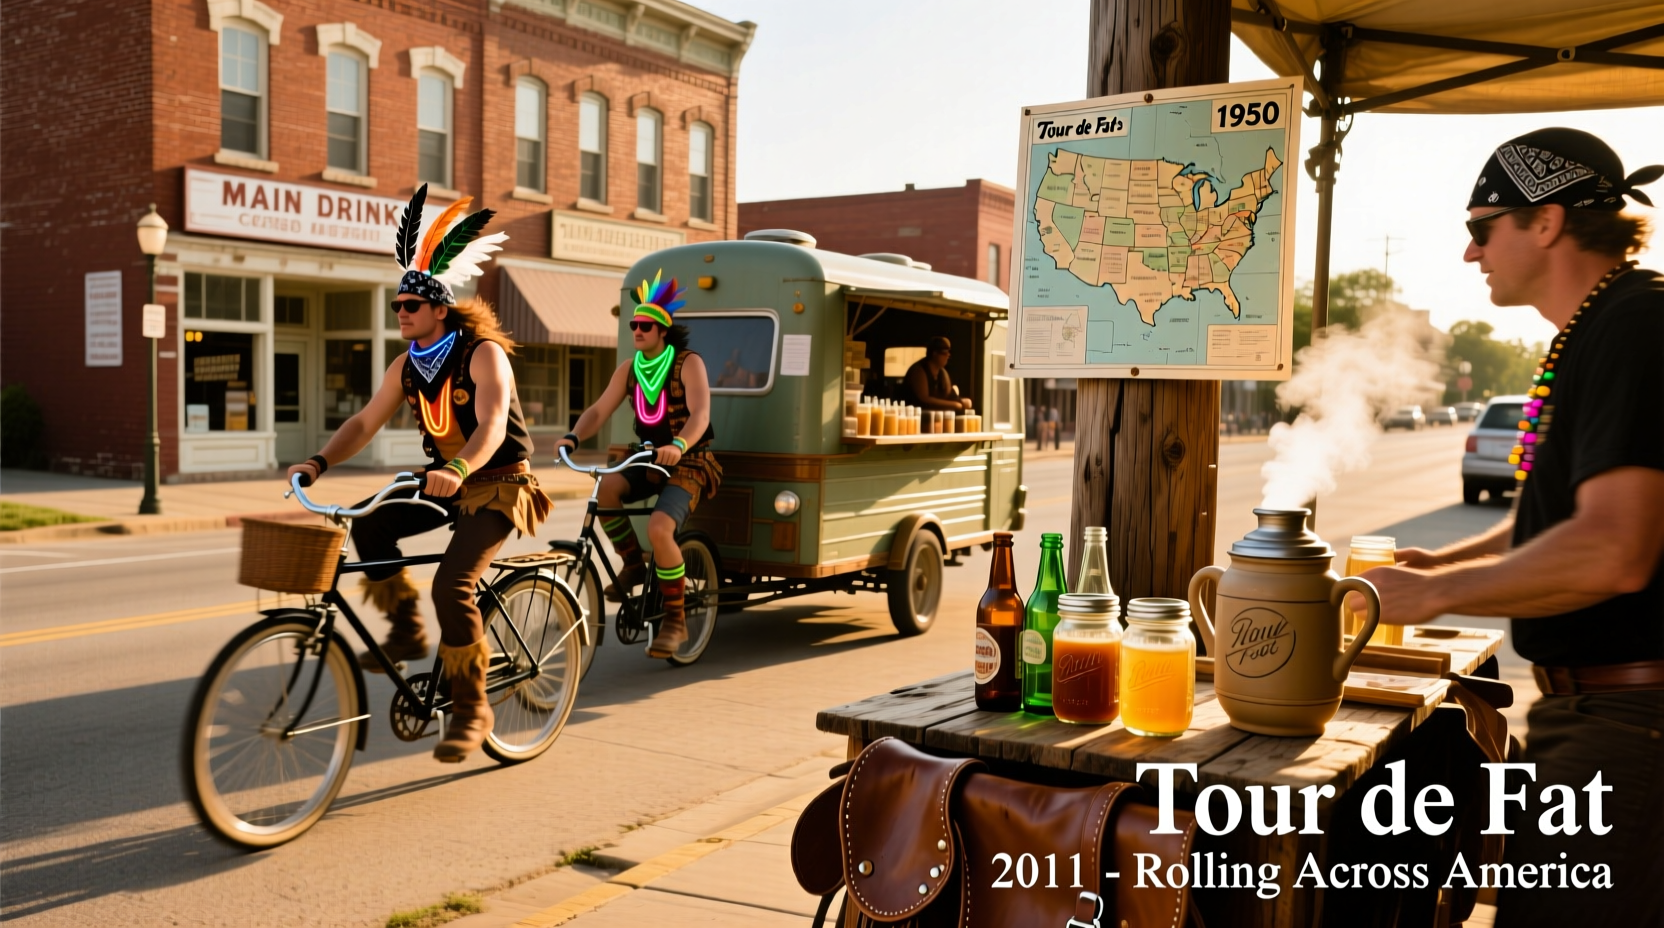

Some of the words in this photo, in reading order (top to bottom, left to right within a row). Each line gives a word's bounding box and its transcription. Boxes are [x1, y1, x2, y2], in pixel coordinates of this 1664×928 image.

[1217, 100, 1280, 128] 1950
[1037, 120, 1074, 140] Tour
[1075, 118, 1092, 136] de
[221, 180, 302, 214] MAIN
